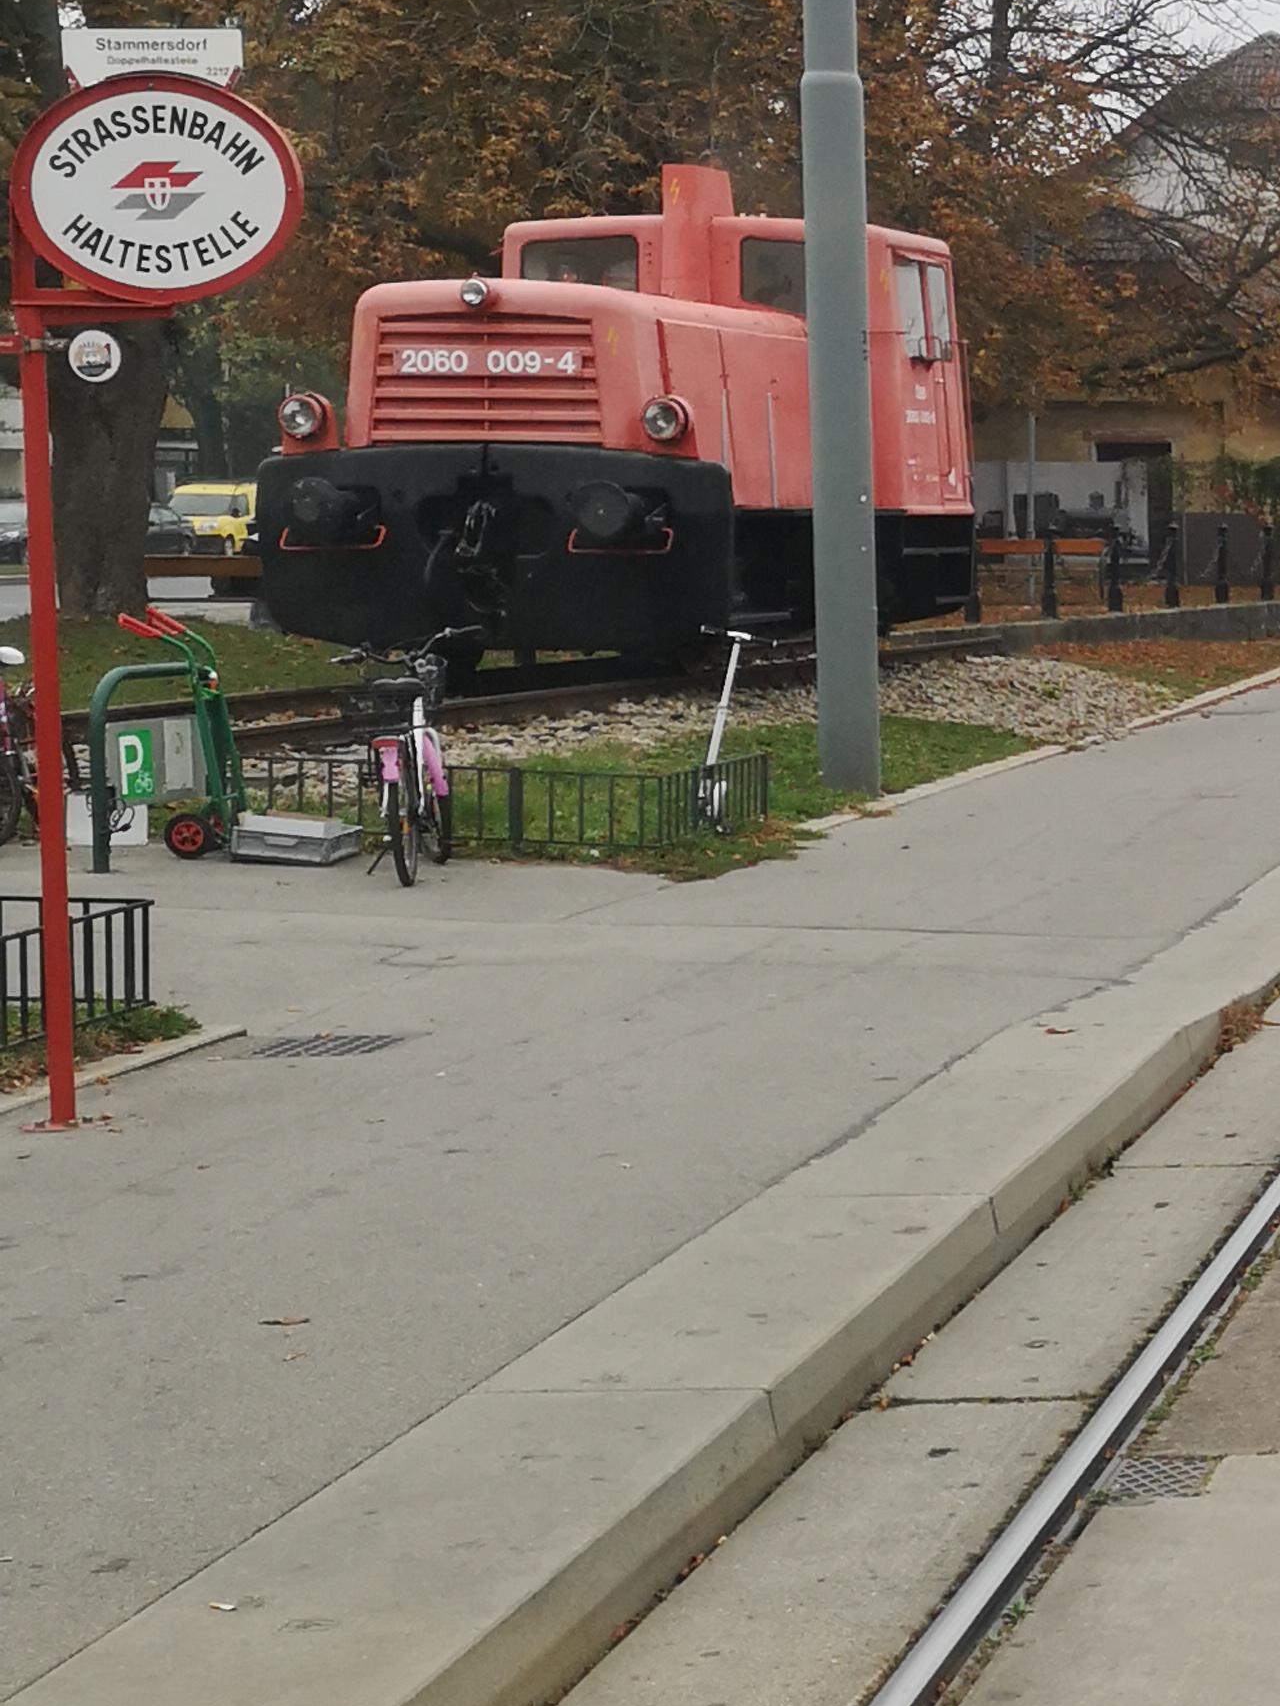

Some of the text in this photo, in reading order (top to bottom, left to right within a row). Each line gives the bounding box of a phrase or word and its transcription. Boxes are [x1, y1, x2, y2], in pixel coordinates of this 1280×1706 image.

[95, 37, 208, 51] Stammersdorf
[49, 104, 266, 178] STRASSENBAHN
[61, 210, 260, 274] HALTESTELLE
[401, 349, 577, 375] 2060 009-4
[118, 734, 144, 796] P
